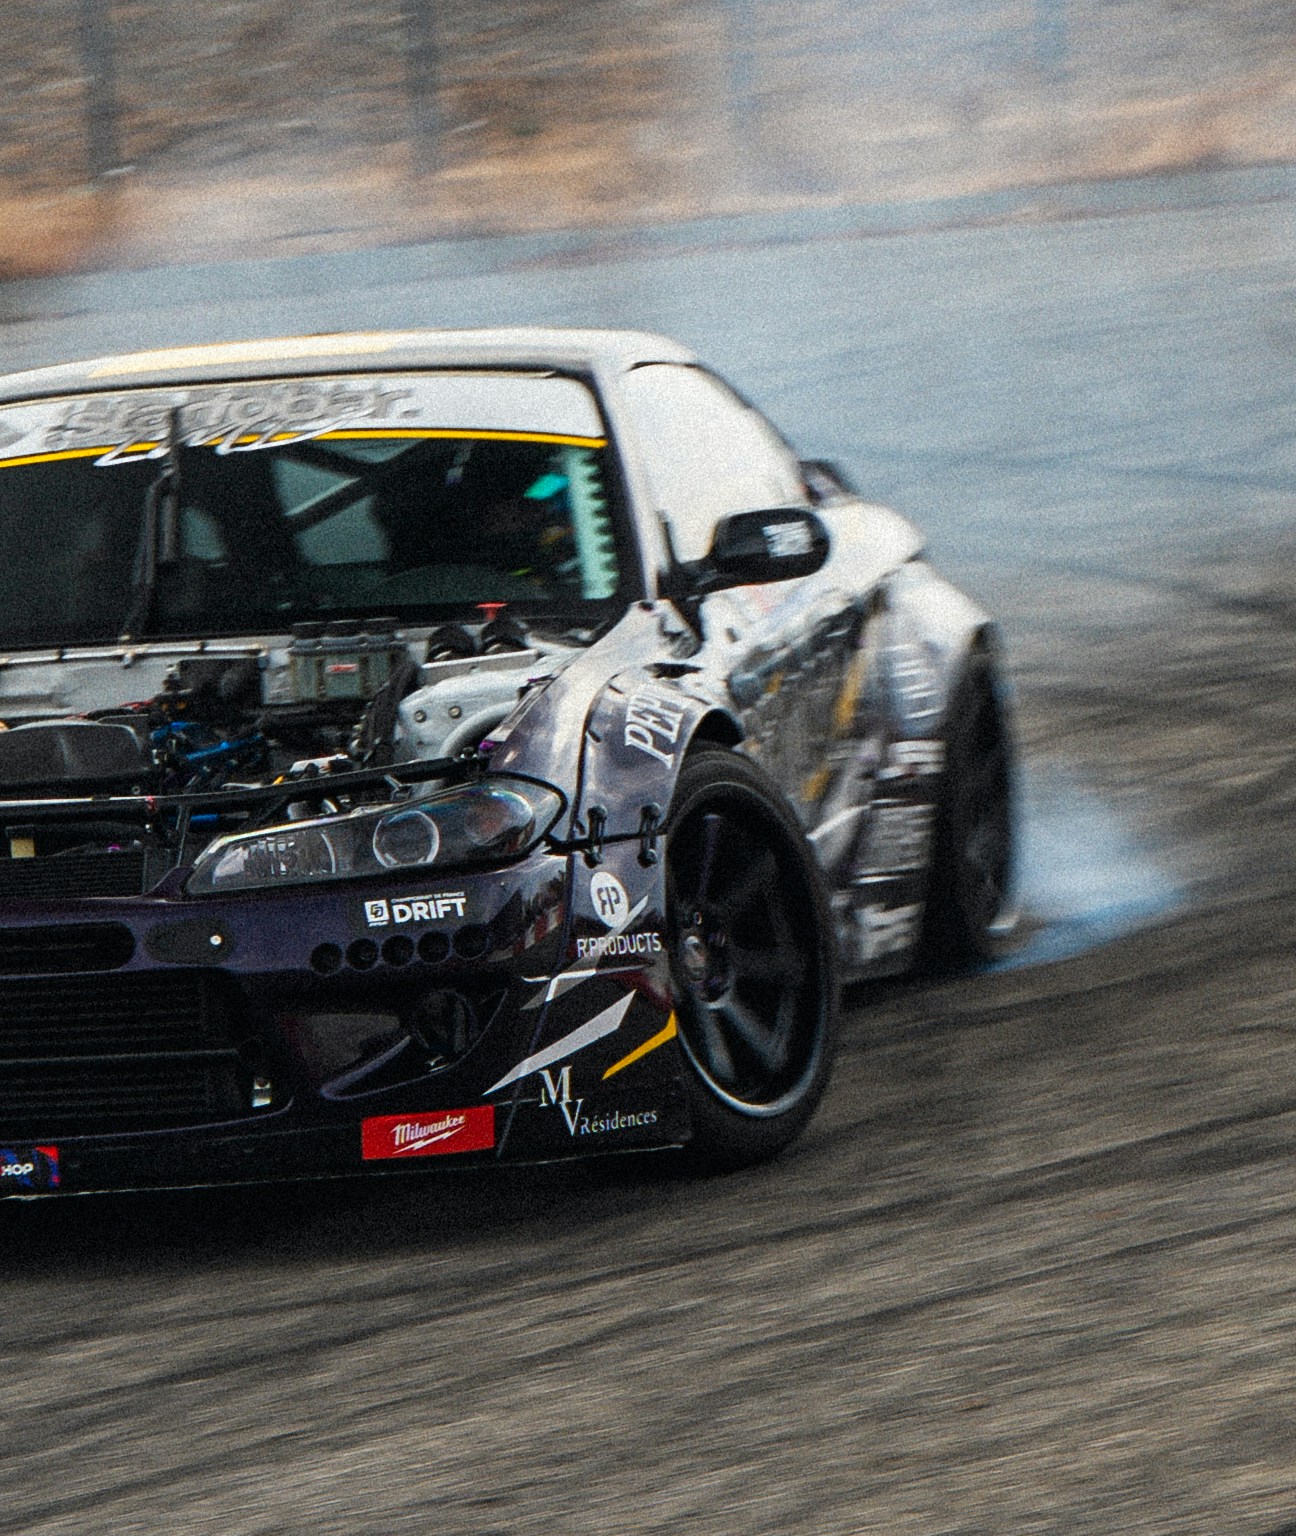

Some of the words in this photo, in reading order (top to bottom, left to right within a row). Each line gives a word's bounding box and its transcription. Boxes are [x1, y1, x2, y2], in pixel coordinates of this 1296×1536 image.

[391, 897, 466, 923] DRIFT
[390, 1114, 466, 1146] Milwaukee
[580, 1110, 658, 1135] Résidences
